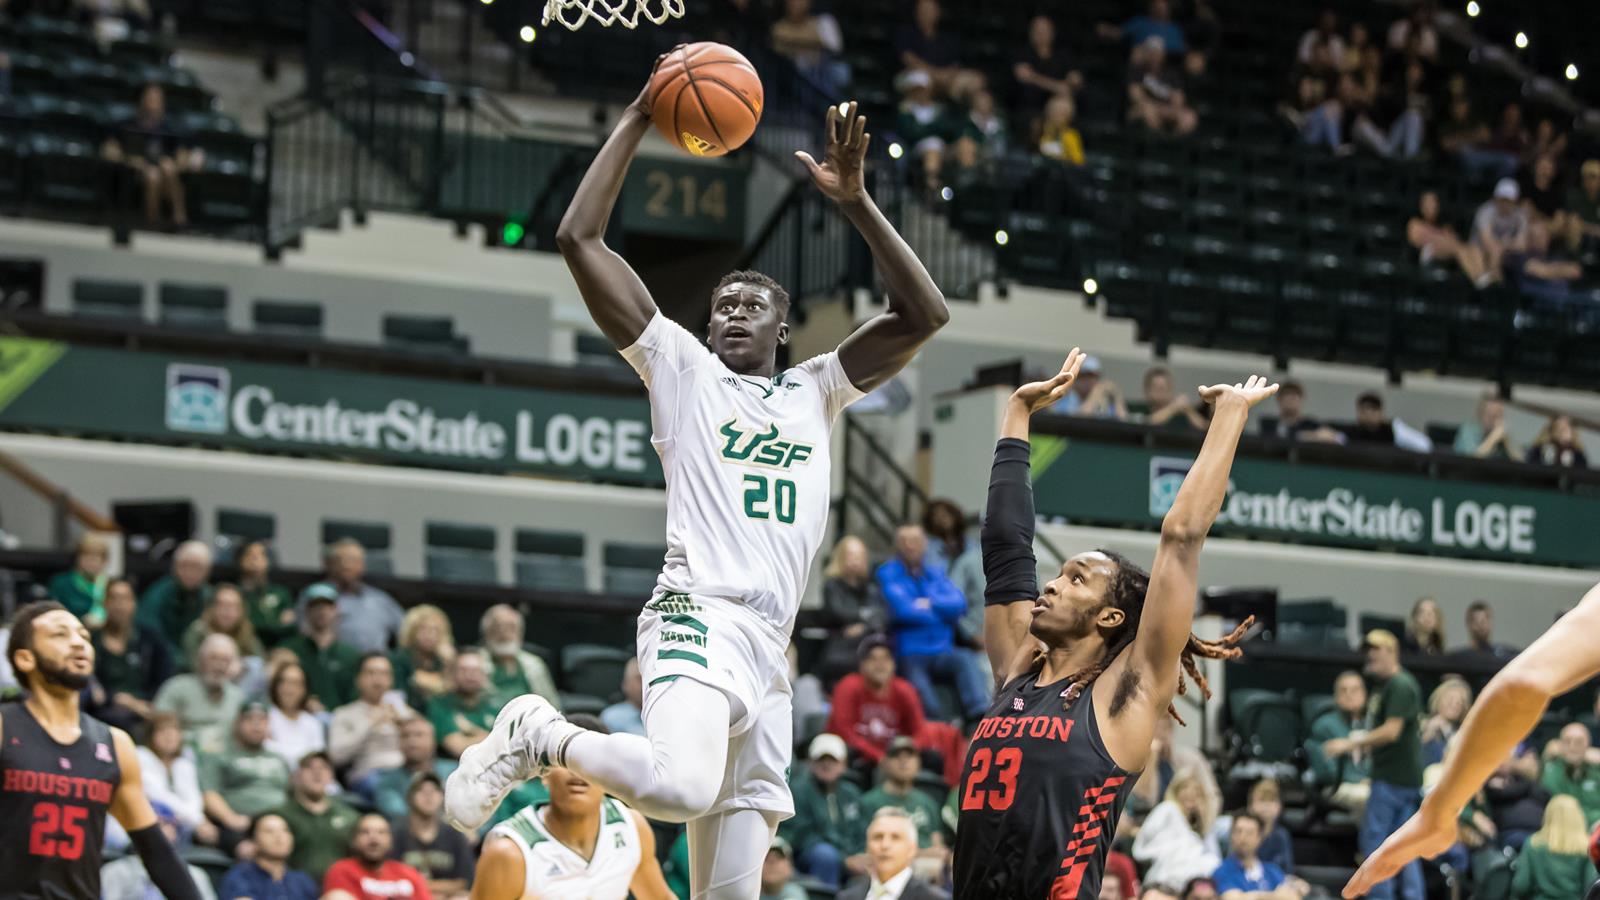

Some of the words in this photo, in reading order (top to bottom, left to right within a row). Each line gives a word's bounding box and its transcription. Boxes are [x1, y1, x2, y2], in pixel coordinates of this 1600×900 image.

[645, 170, 729, 222] 214
[230, 384, 507, 459] CenterState
[515, 410, 648, 473] LOGE
[717, 413, 815, 470] USF
[743, 473, 797, 525] 20
[1431, 497, 1537, 554] LOGE
[971, 715, 1075, 742] OUSTON
[3, 768, 112, 804] HOUSTON
[961, 747, 1023, 811] 23
[28, 801, 89, 860] 25
